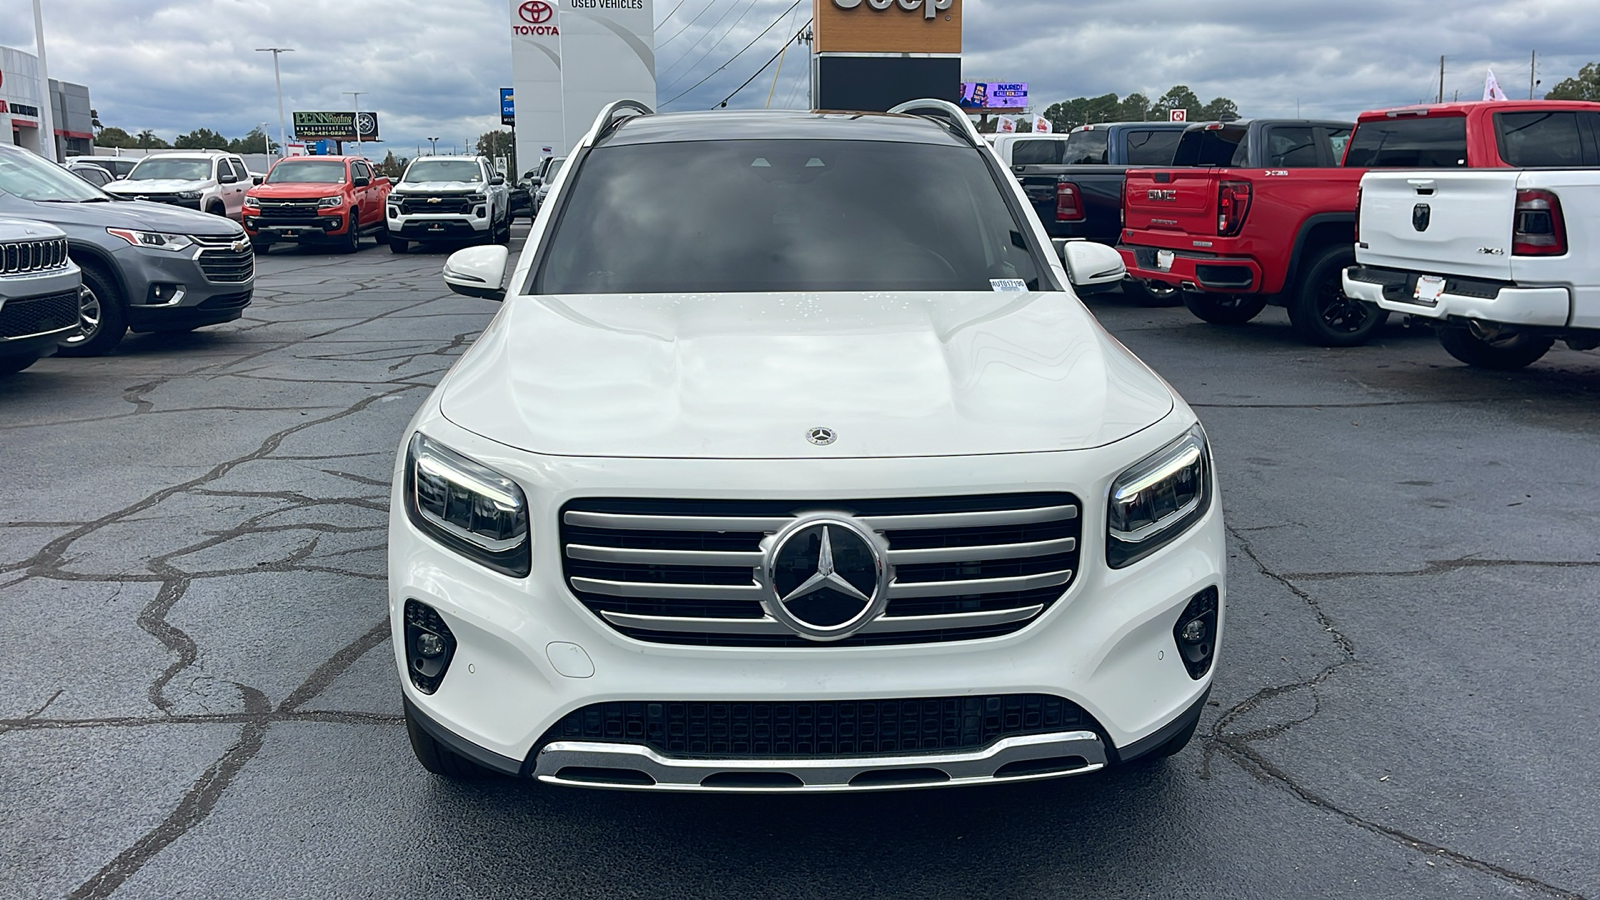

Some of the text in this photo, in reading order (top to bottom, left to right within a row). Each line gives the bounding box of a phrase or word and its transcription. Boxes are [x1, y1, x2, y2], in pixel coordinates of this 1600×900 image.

[571, 0, 643, 9] USED VEHICLES
[513, 26, 560, 36] TOYOTA
[296, 113, 352, 125] PENN Roofing
[1148, 189, 1176, 200] GMC
